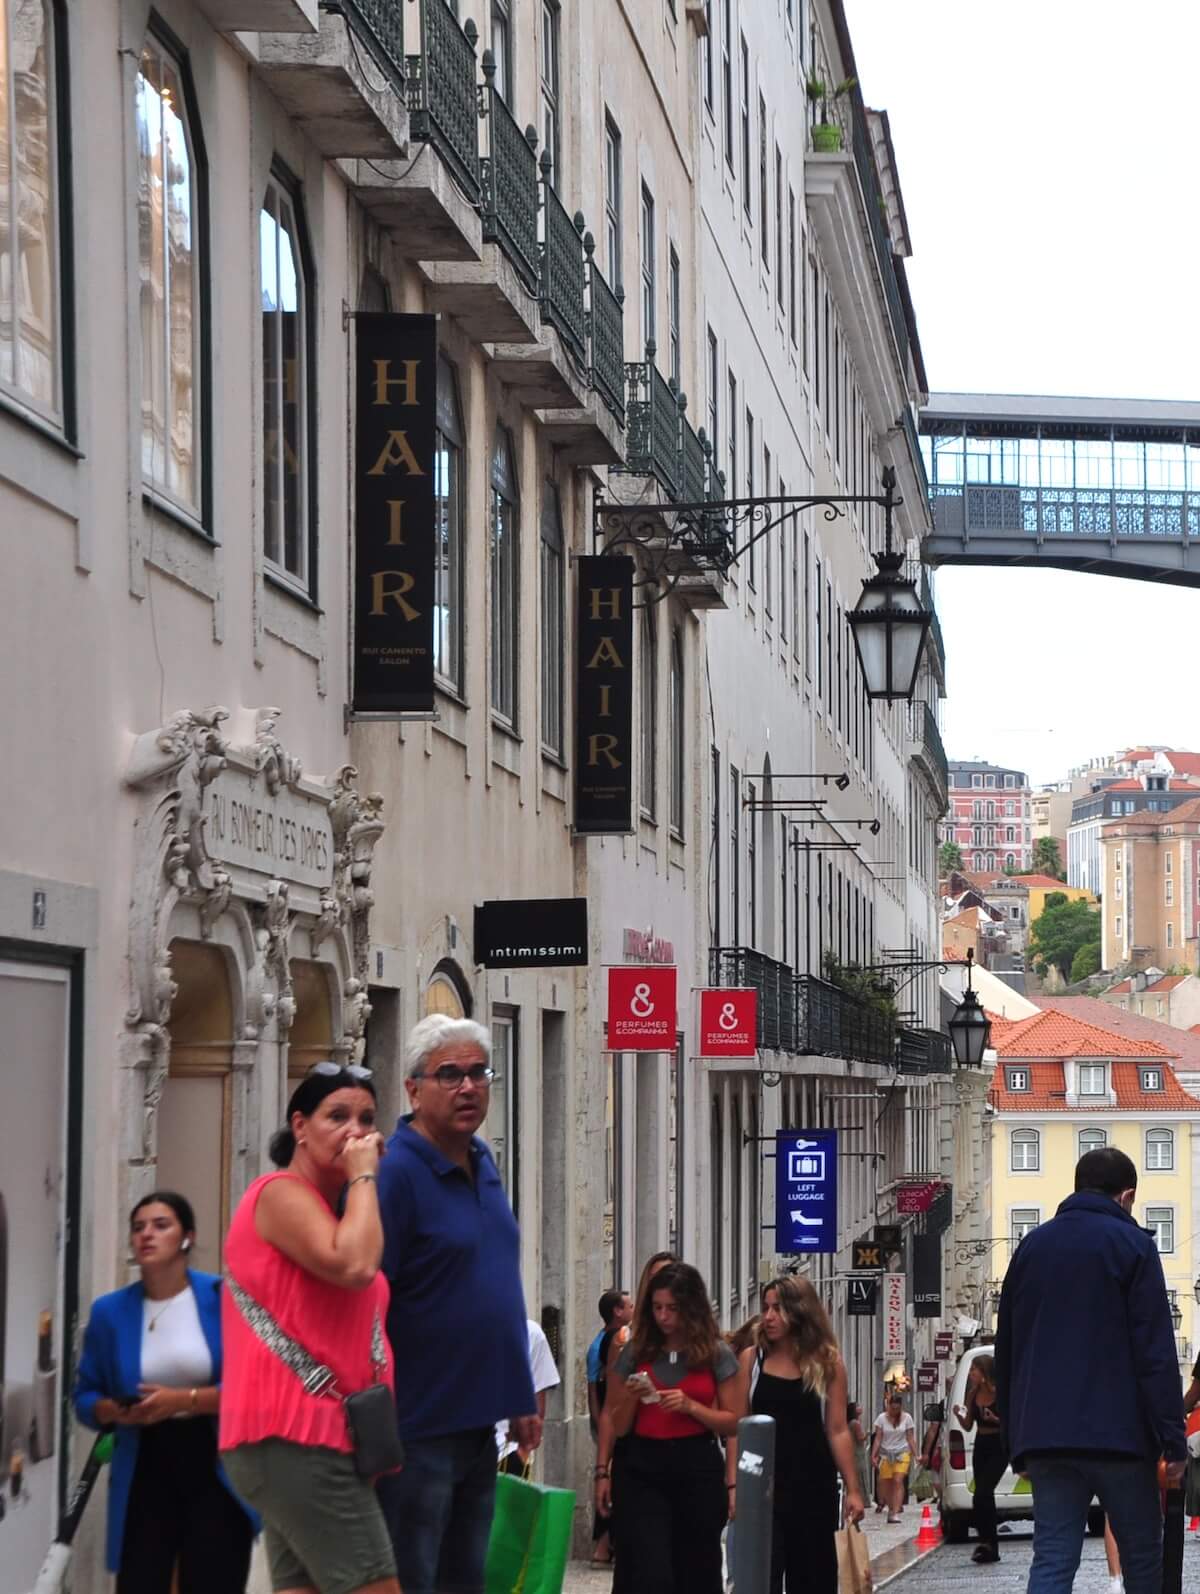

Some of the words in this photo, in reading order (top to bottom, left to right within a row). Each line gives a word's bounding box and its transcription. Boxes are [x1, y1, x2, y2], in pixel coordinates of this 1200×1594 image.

[367, 359, 426, 622] HAIR
[586, 587, 625, 769] HAIR
[490, 946, 582, 957] intimissimi
[616, 1020, 668, 1028] PERFUMES
[797, 1184, 816, 1192] LEFT
[788, 1193, 825, 1201] LUGGAGE
